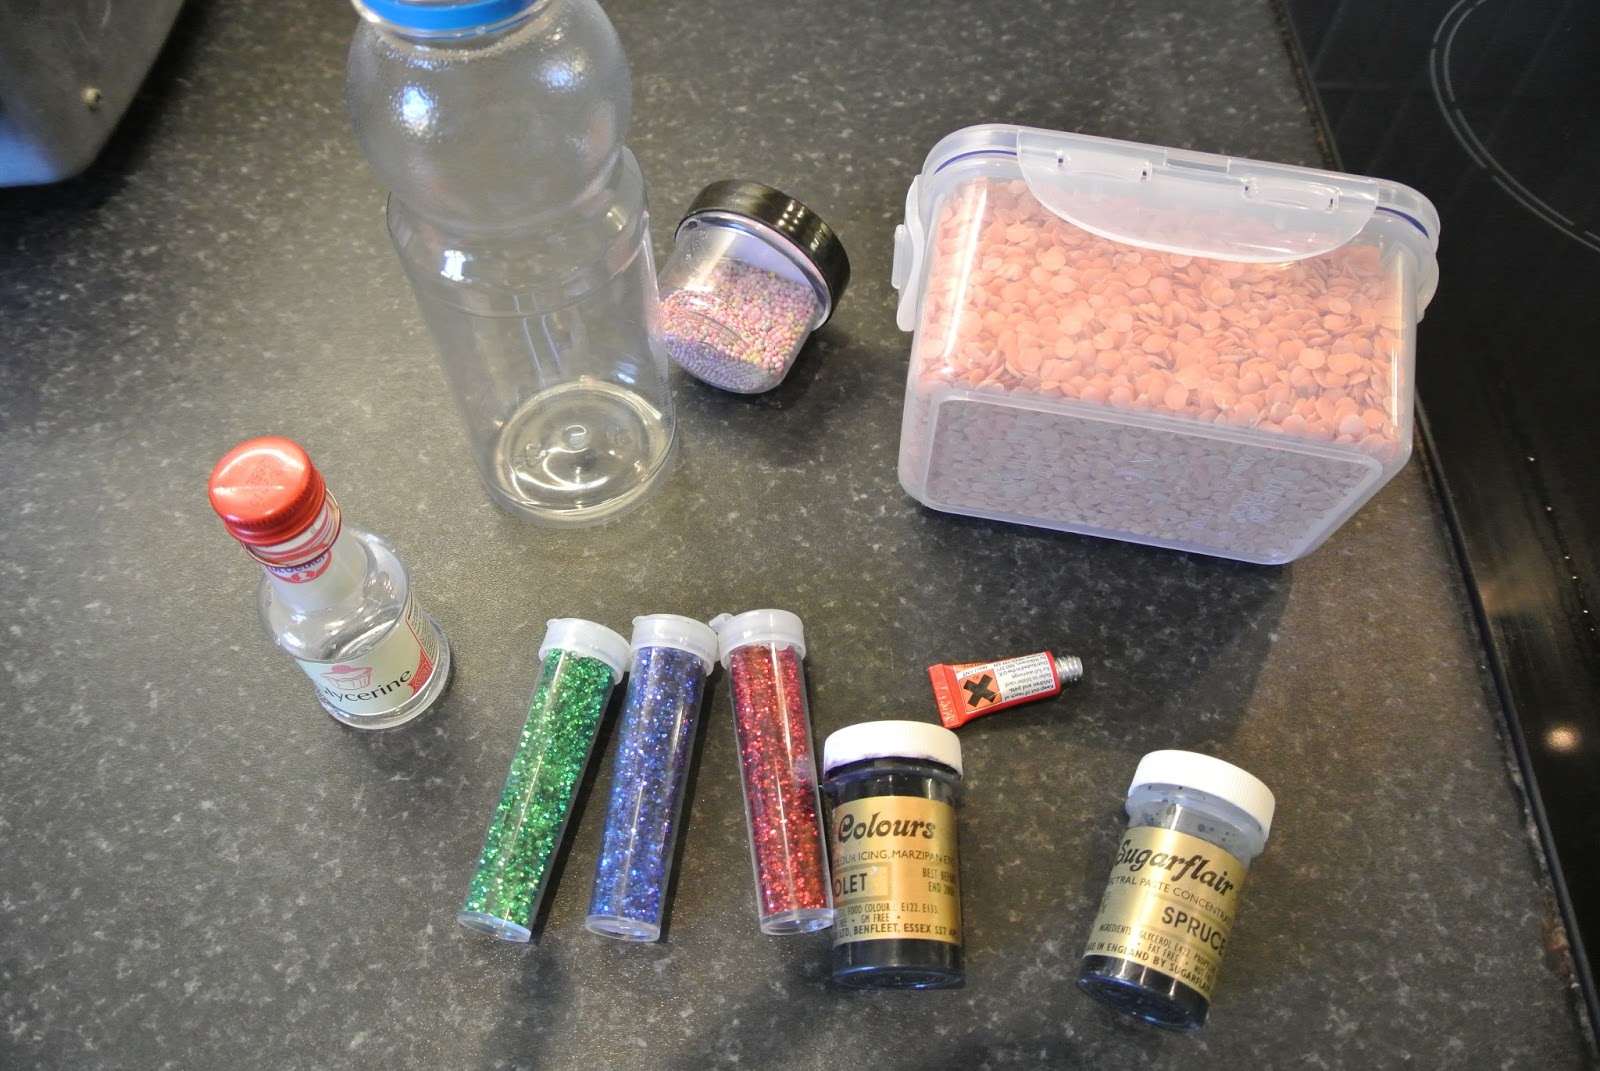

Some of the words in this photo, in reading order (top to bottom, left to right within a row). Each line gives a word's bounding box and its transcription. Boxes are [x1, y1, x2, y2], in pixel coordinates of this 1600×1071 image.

[1020, 660, 1047, 670] Distributed
[325, 671, 411, 701] lycerine
[1032, 678, 1052, 687] children
[839, 811, 936, 843] Colours
[858, 850, 891, 861] ICING,
[892, 850, 942, 863] MARZIPAN
[922, 868, 937, 879] BEST
[1114, 839, 1233, 896] Sugarflair
[834, 873, 868, 898] OLET
[928, 882, 941, 893] END
[848, 904, 862, 915] FOOD
[865, 903, 890, 912] COLOUR
[874, 913, 890, 922] FREE
[854, 924, 900, 935] BENFLEET,
[903, 924, 931, 934] ESSEX
[1162, 906, 1227, 956] SPRUCE
[1139, 930, 1172, 949] GLYCEROL
[1148, 944, 1160, 953] FAT
[1162, 948, 1180, 963] FREE
[1153, 959, 1167, 968] BY
